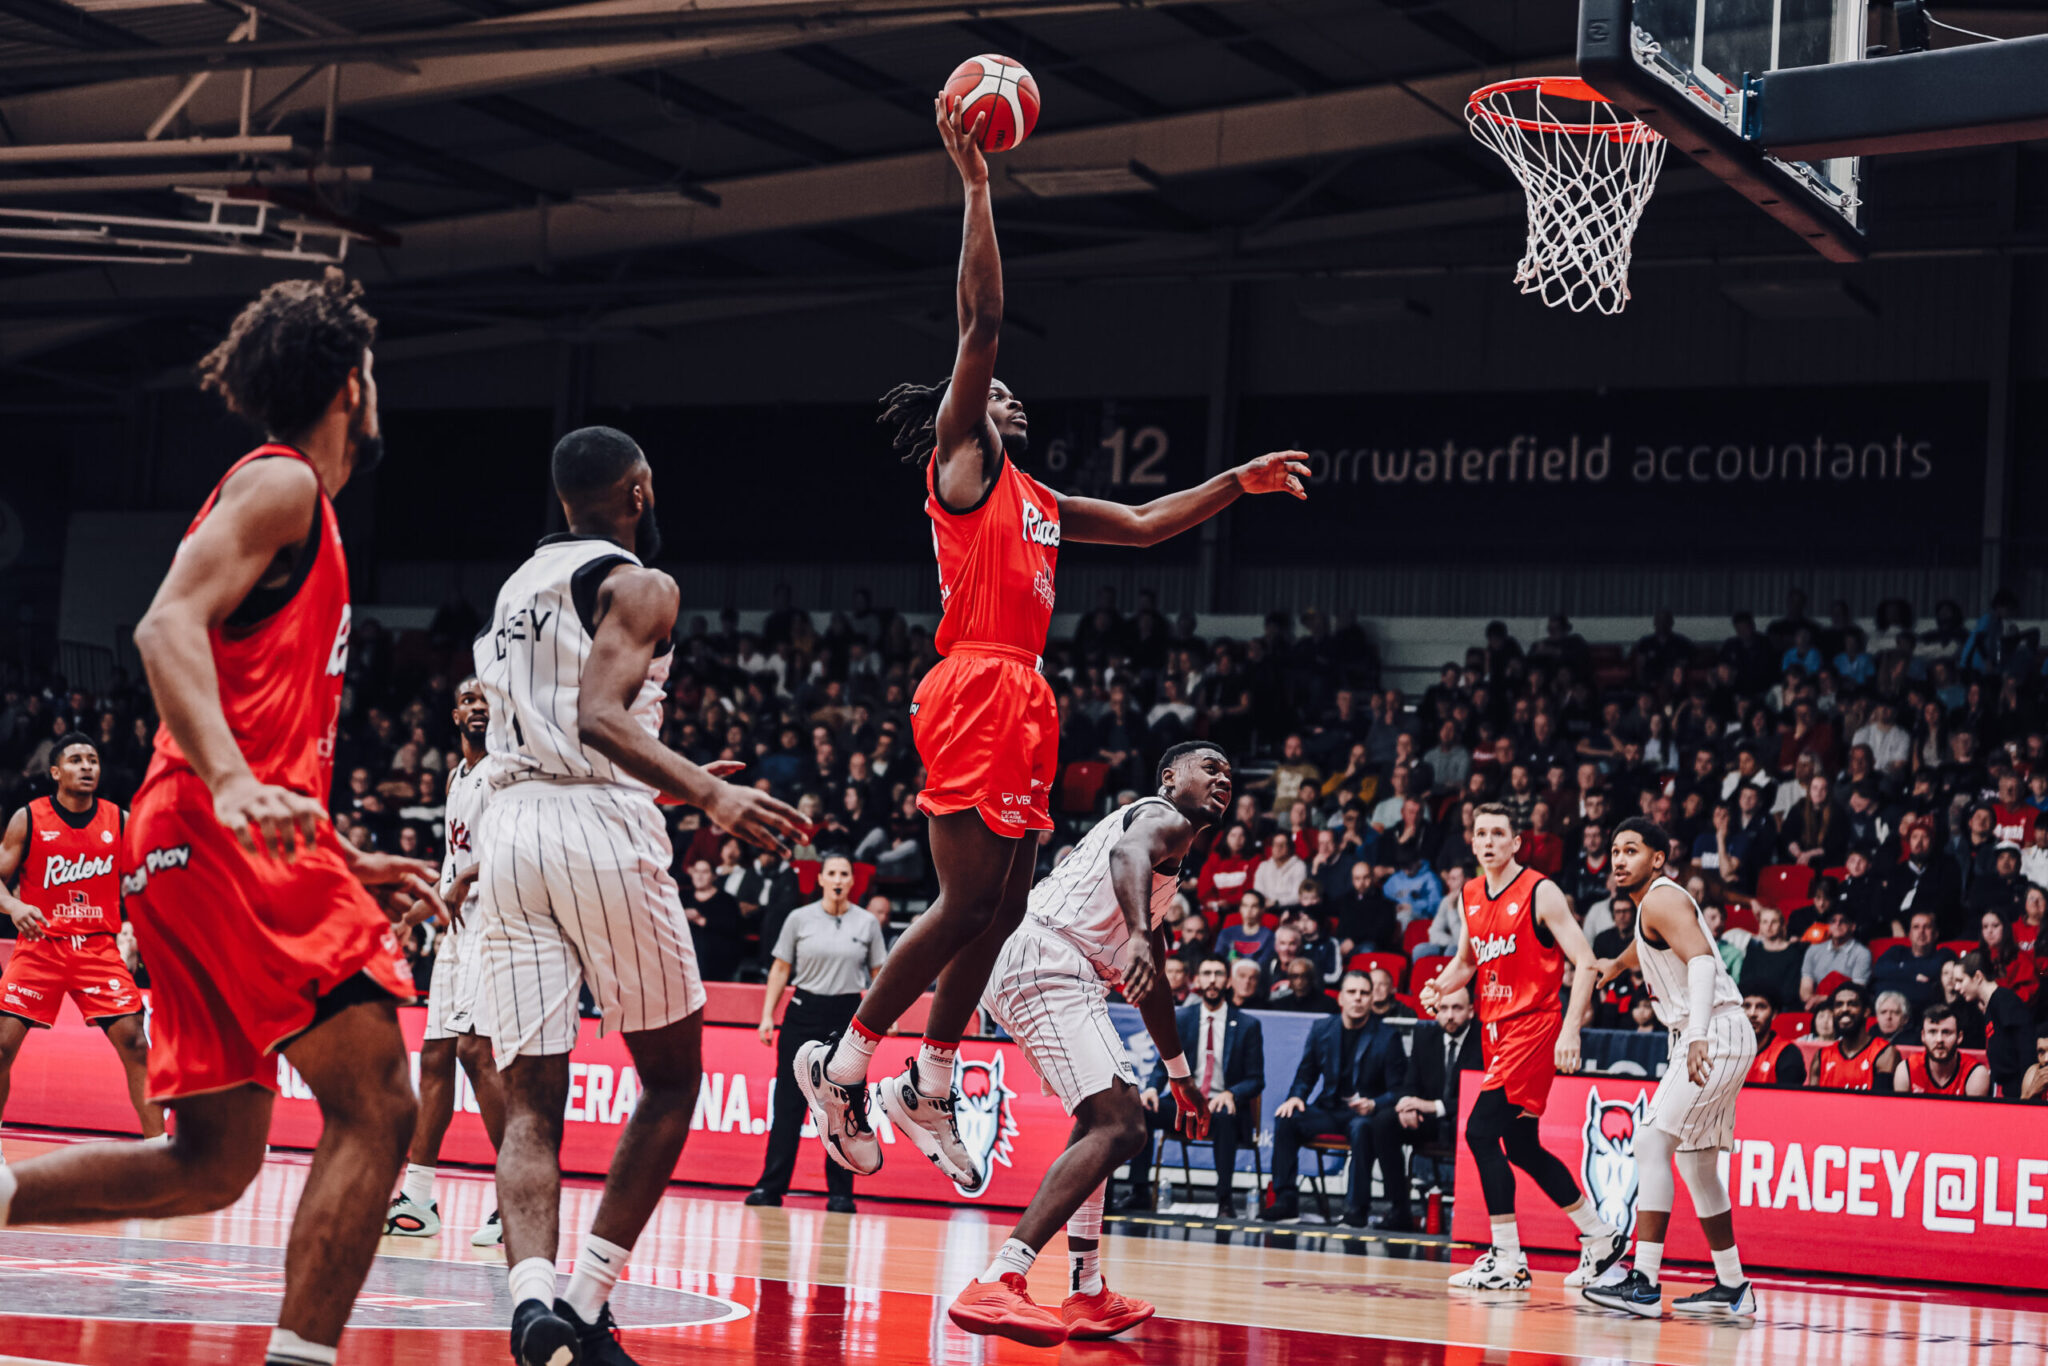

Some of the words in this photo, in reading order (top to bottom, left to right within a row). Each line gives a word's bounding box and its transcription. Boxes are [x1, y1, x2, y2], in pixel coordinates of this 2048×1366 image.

[1099, 425, 1165, 487] 12
[1296, 434, 1611, 483] orrwaterfield
[1632, 432, 1932, 482] accountants
[43, 852, 114, 890] Riders
